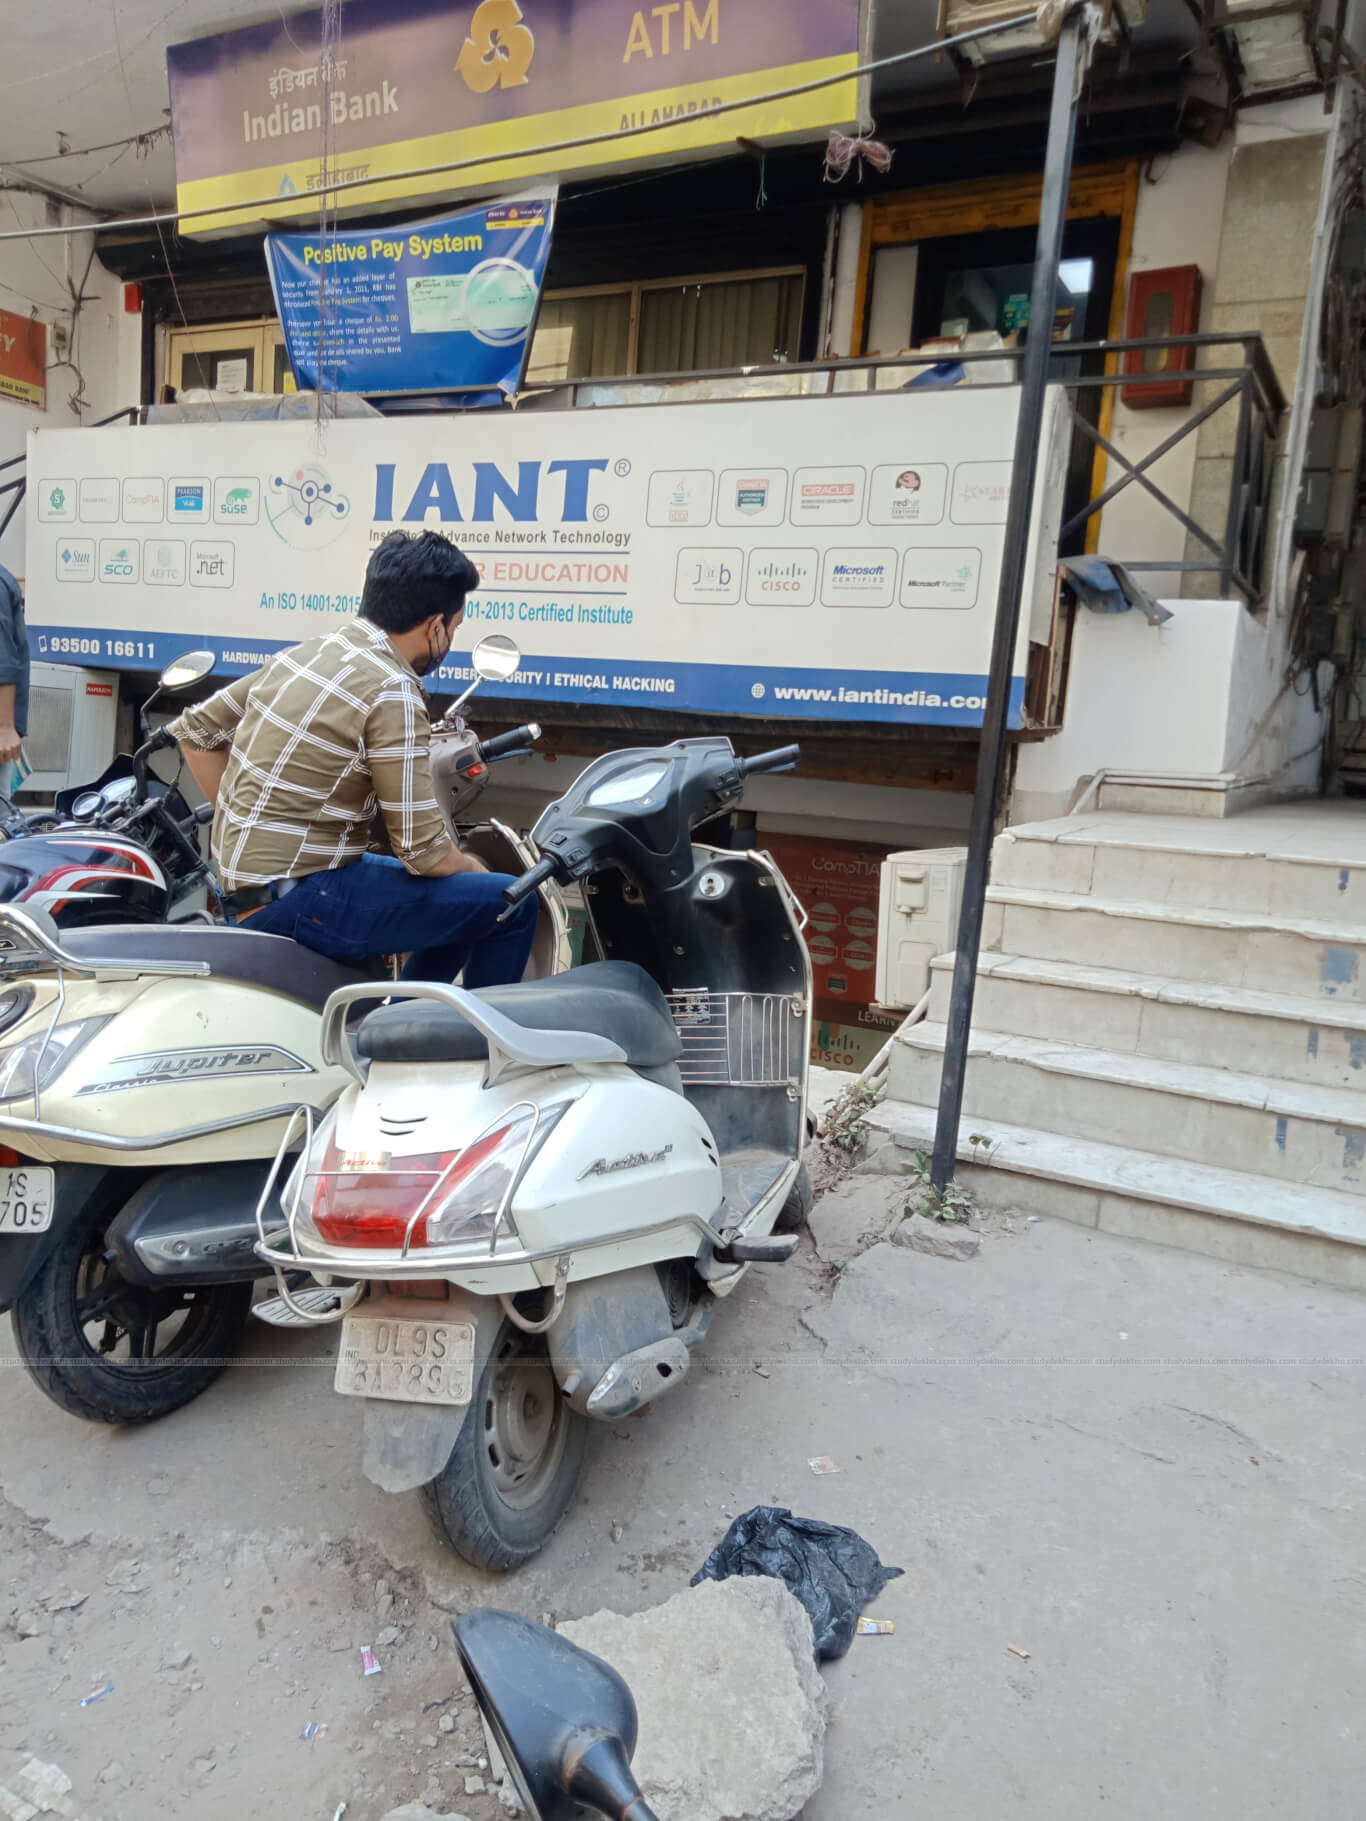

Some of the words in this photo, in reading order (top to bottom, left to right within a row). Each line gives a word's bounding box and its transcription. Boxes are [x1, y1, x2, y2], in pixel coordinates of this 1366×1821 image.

[623, 0, 719, 63] ATM
[243, 103, 321, 142] Indian
[329, 80, 399, 125] Bank
[303, 245, 367, 264] Positive
[371, 239, 404, 262] Pay
[408, 234, 483, 260] System
[373, 459, 610, 522] IANT
[495, 530, 546, 544] Network
[552, 530, 631, 547] Technology
[493, 562, 628, 583] EDUCATION
[833, 565, 884, 575] Microsoft
[761, 581, 801, 591] CISCO
[260, 592, 275, 608] An
[278, 592, 297, 610] ISO
[300, 593, 361, 612] 14001-2015
[464, 600, 515, 620] 01-2013
[519, 602, 573, 623] Certified
[578, 604, 633, 624] Institute
[51, 638, 99, 654] 93500
[106, 640, 154, 658] 16611
[222, 651, 273, 664] HARDWAR
[438, 666, 477, 680] CYBER
[554, 673, 608, 689] ETHICAL
[613, 676, 675, 693] HACKING
[774, 687, 987, 709] www.iantindia.co
